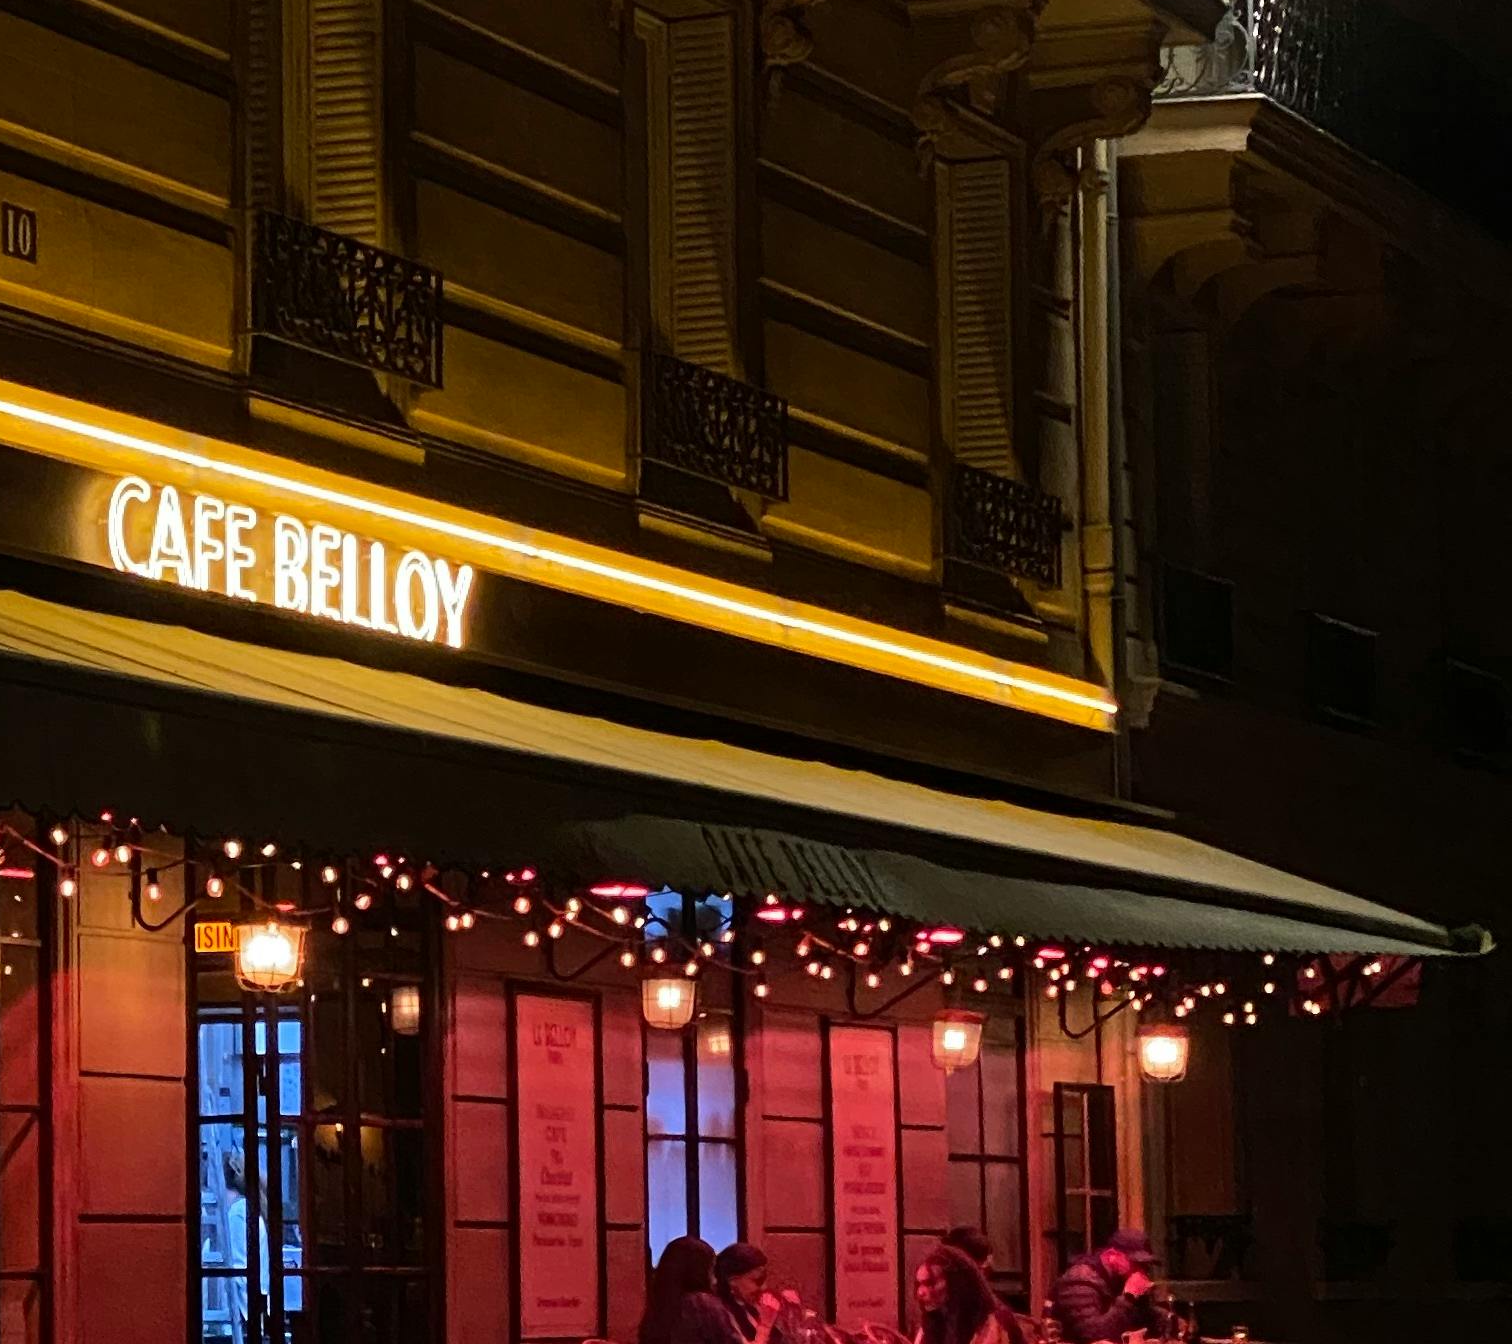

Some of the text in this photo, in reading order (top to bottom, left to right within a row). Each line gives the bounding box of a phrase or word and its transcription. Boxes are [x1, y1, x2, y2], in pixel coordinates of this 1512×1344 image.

[8, 209, 31, 256] 10
[108, 475, 473, 649] CAFE BELLOY
